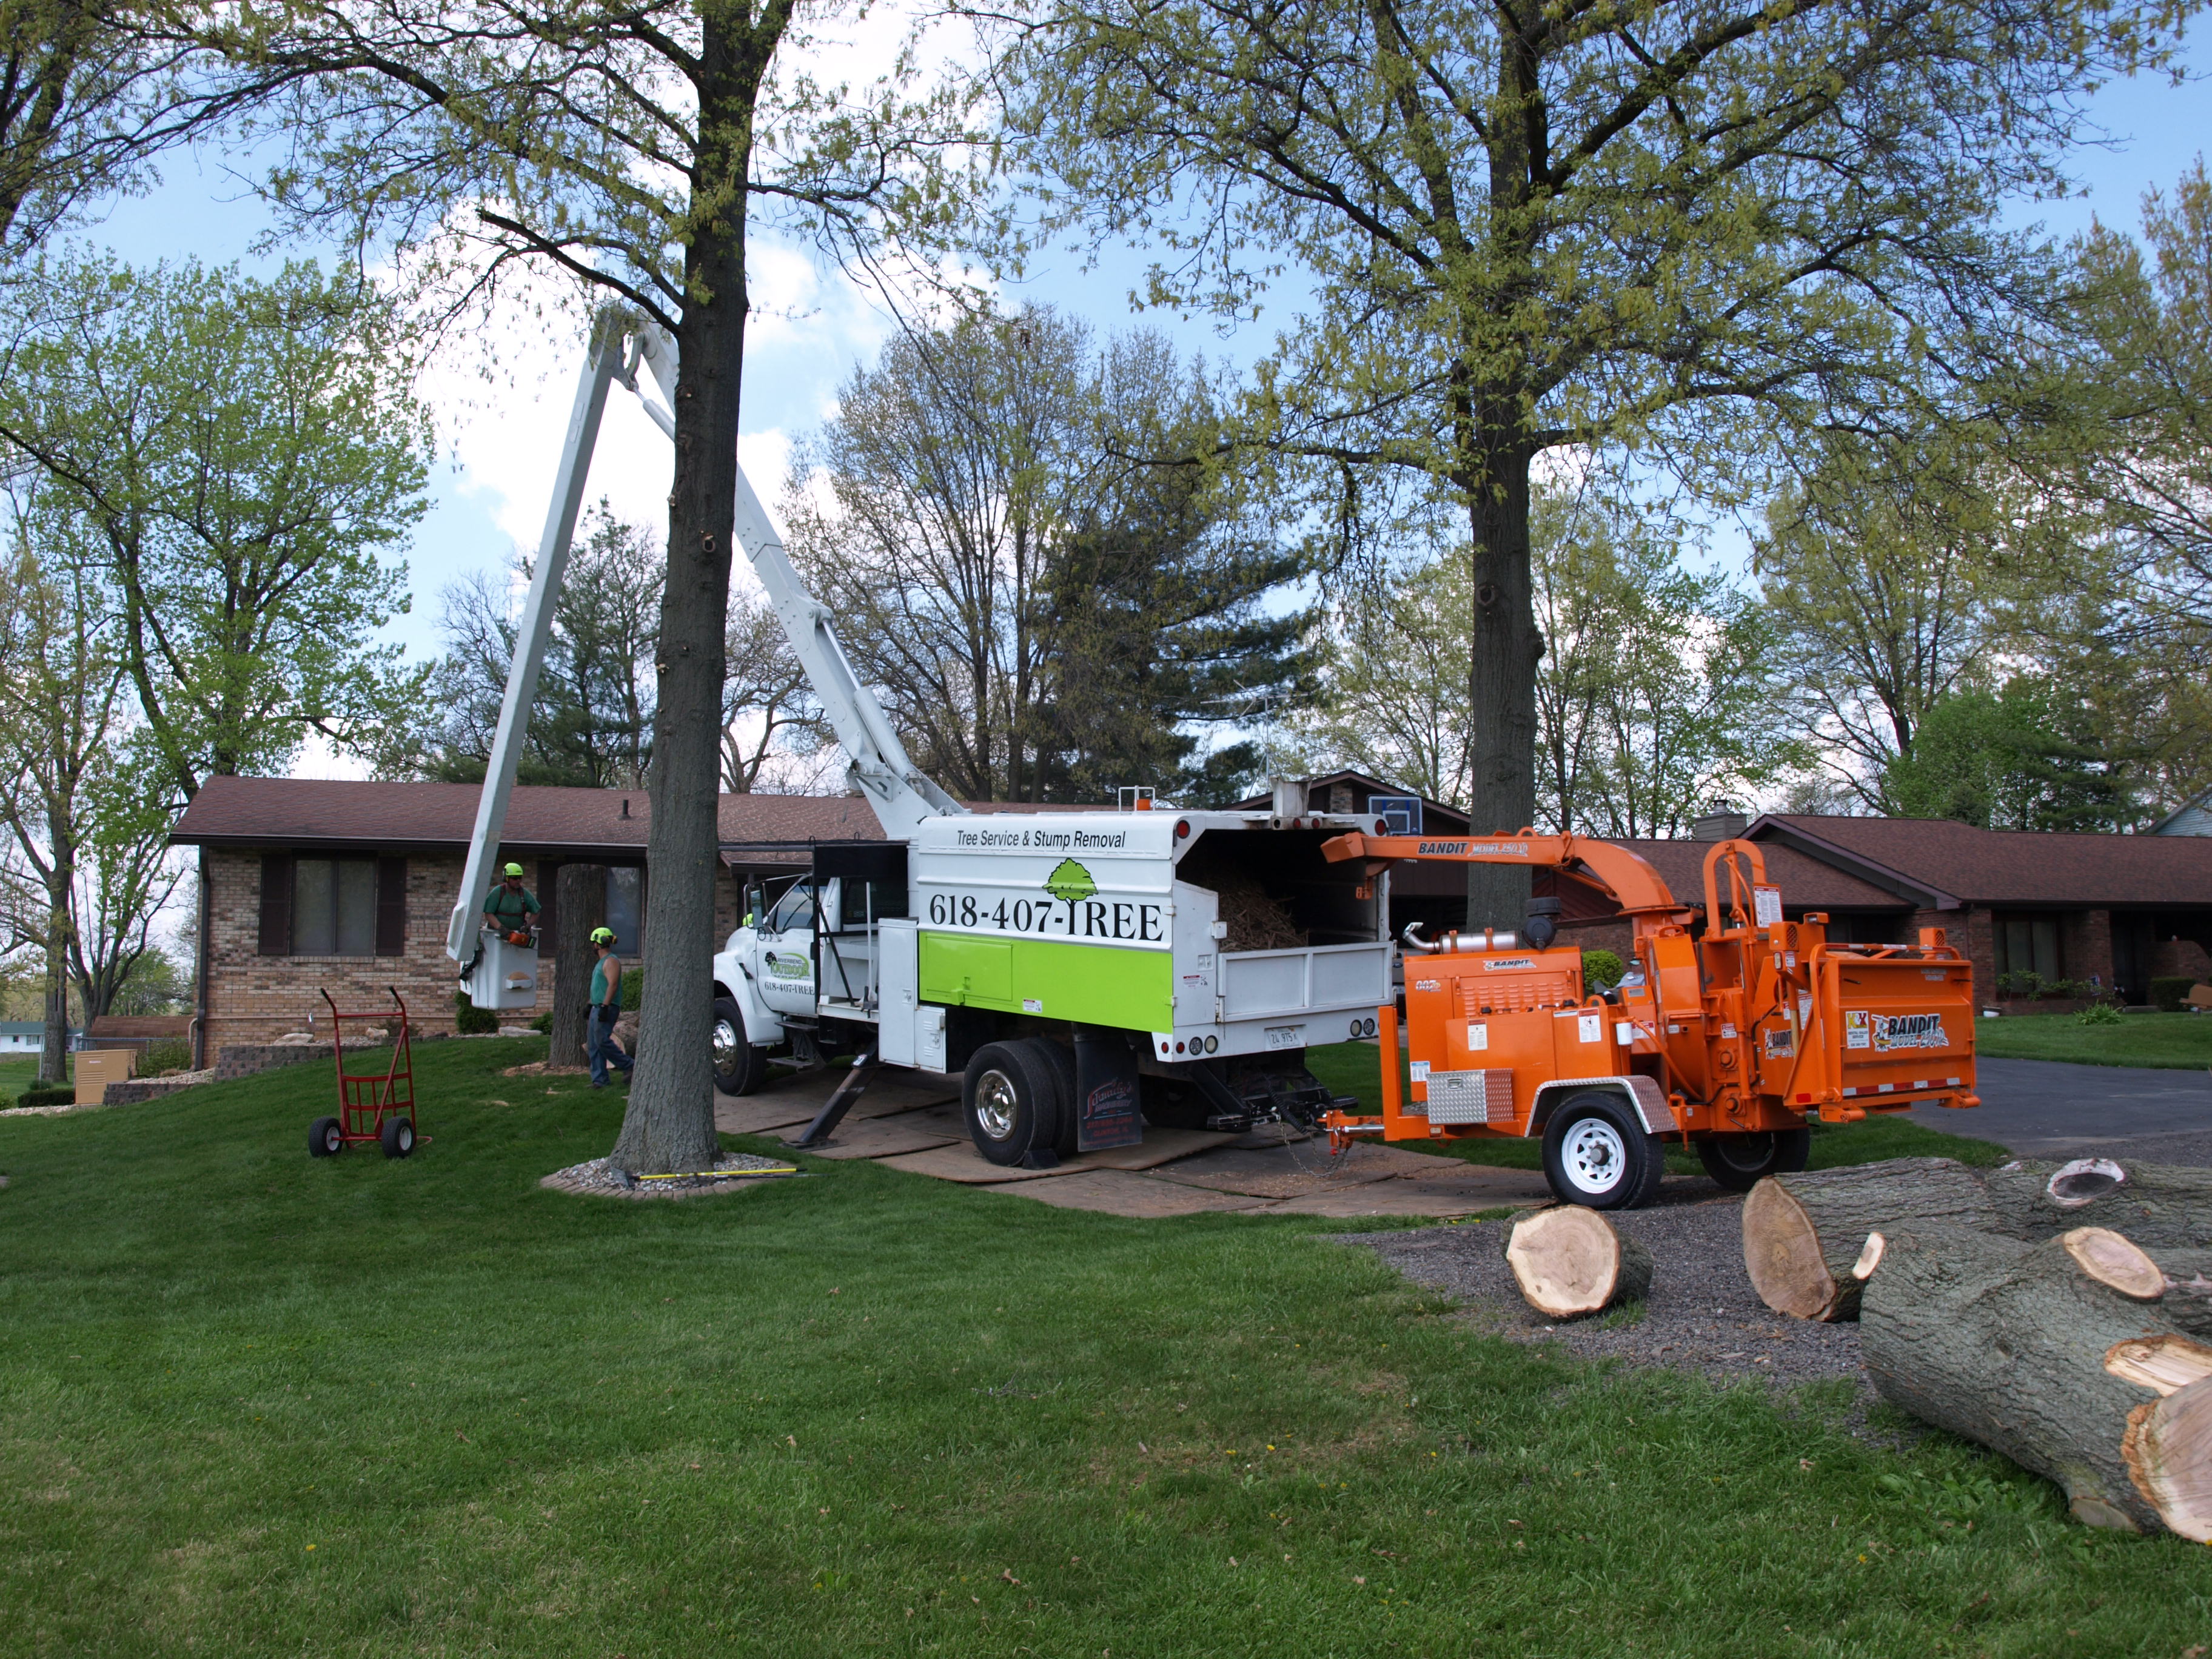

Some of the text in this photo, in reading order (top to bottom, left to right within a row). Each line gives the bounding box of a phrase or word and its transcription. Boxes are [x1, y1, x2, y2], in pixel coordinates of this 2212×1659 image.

[957, 830, 1125, 851] Tree Service & Stump Removal
[1418, 842, 1468, 854] BANDIT
[1888, 1015, 1940, 1036] BANDIT
